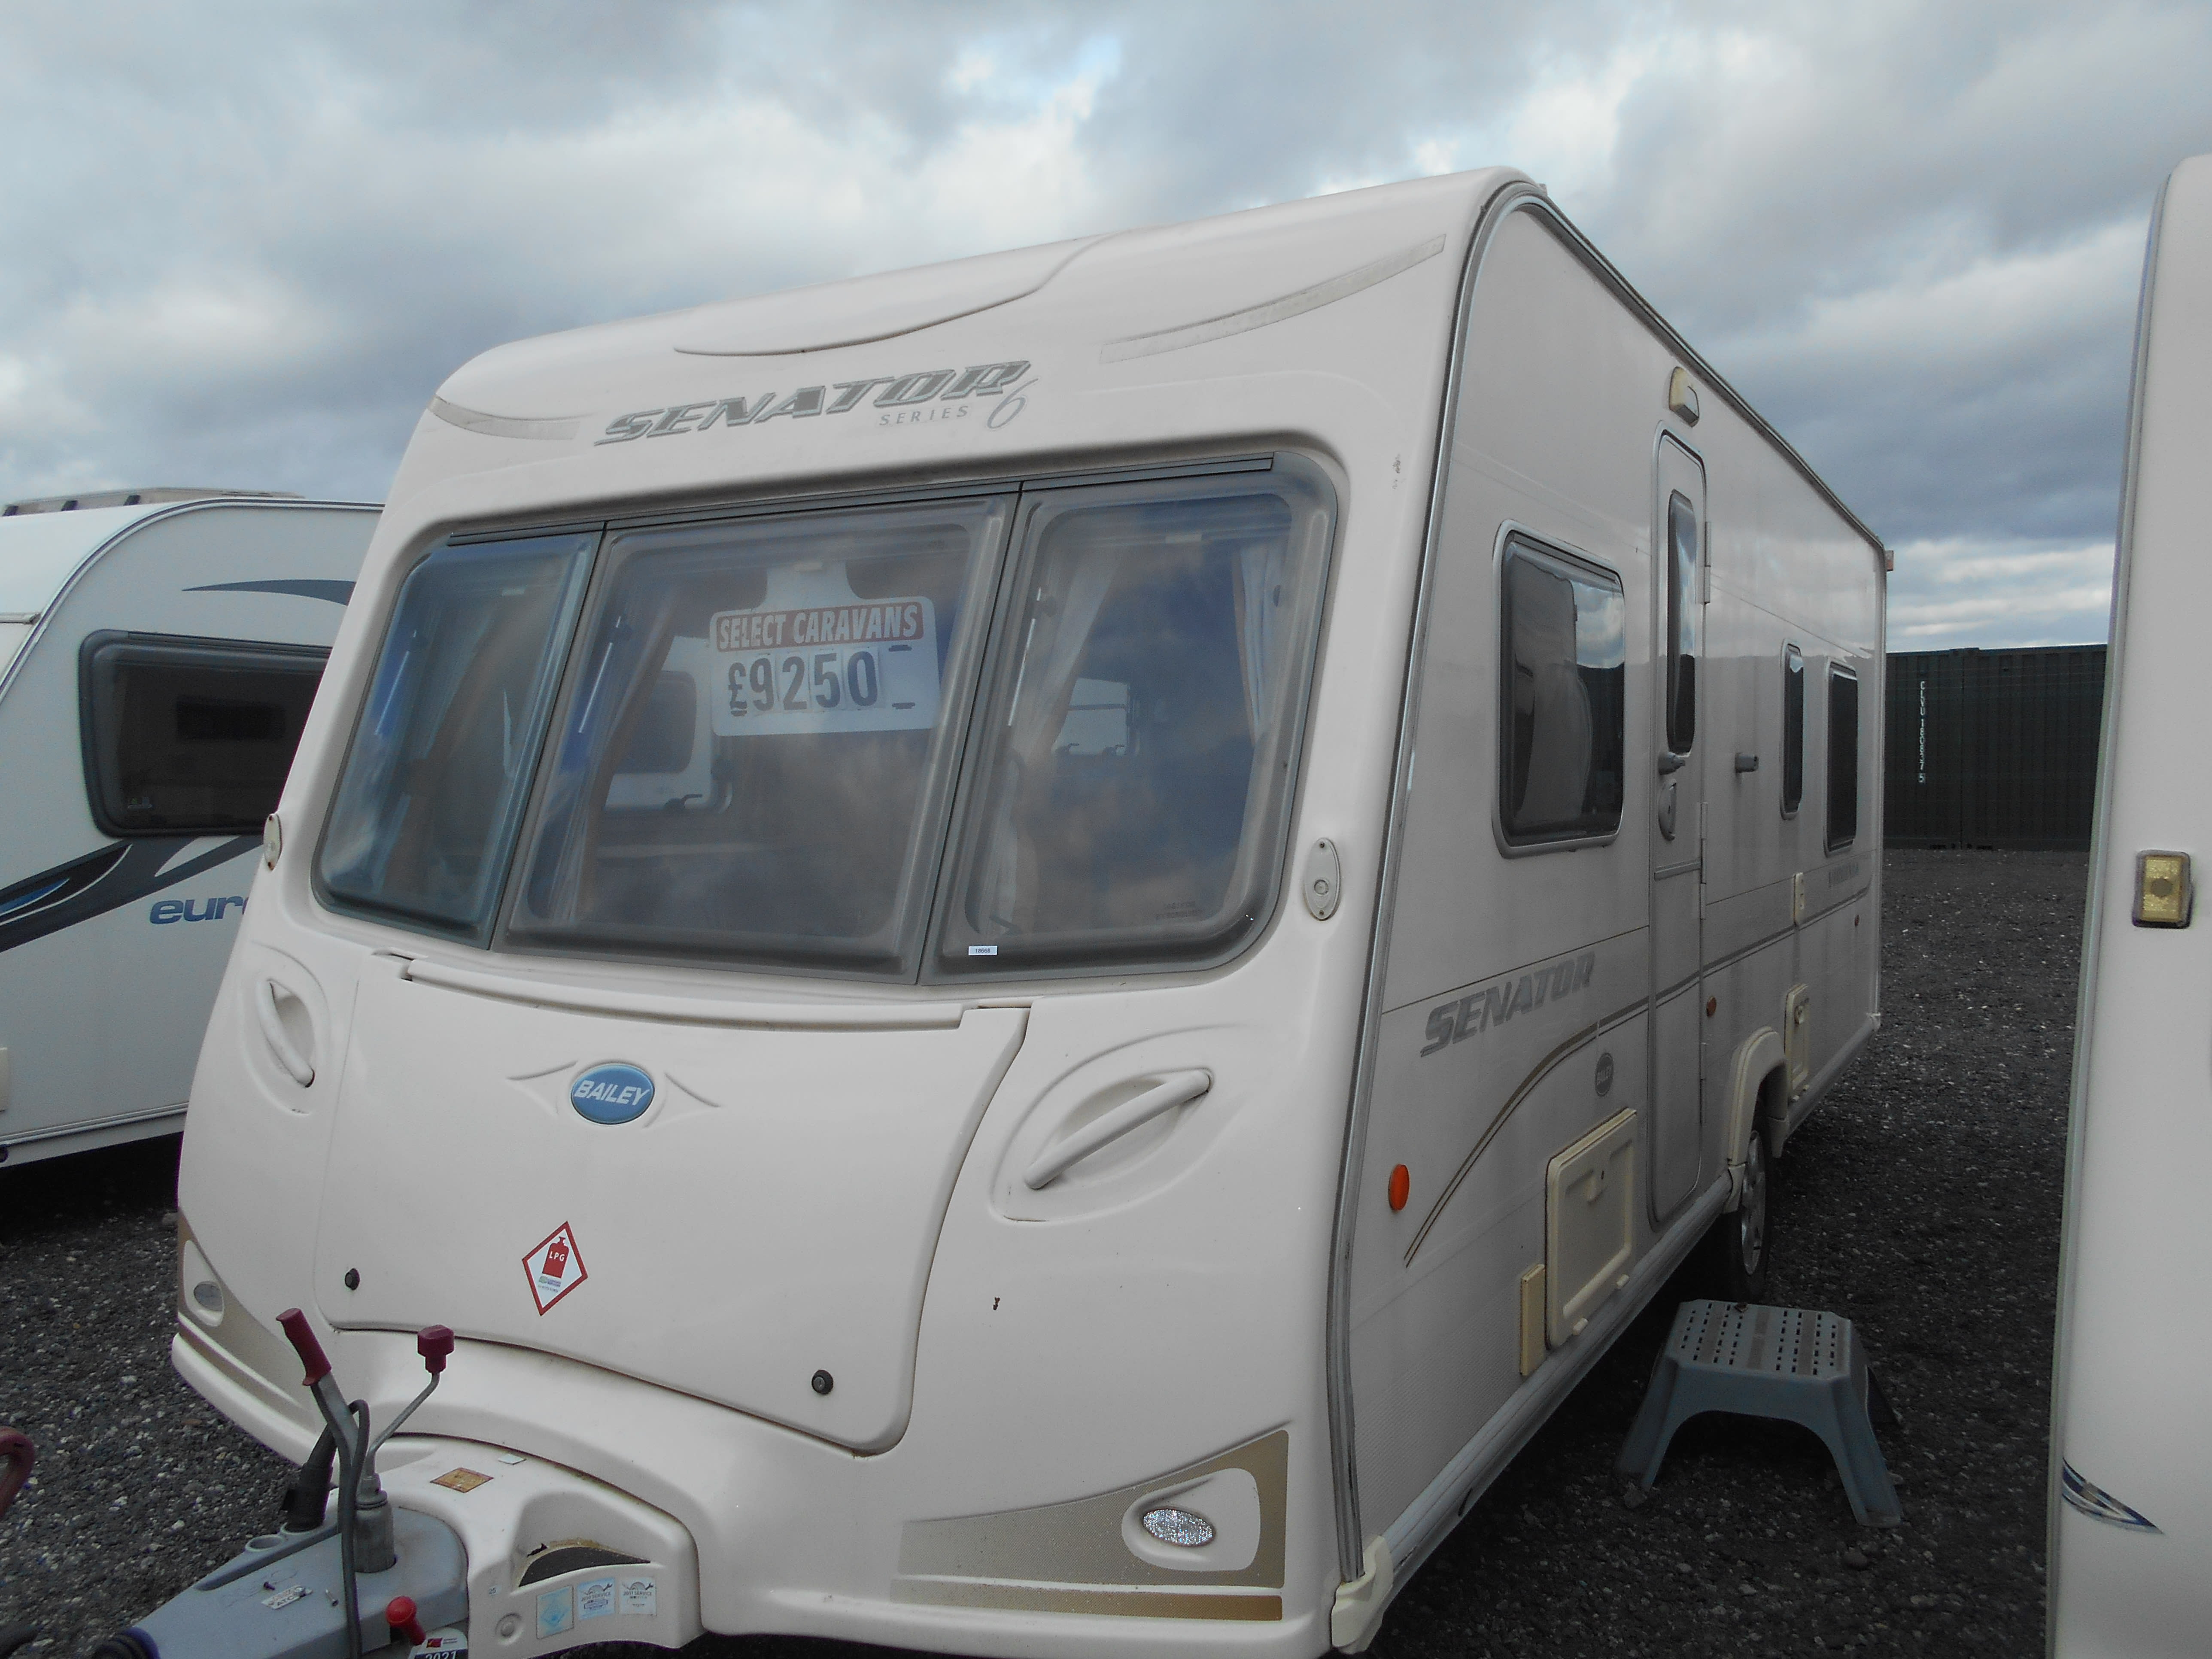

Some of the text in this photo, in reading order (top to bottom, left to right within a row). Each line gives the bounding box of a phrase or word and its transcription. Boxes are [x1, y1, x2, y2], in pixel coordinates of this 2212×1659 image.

[595, 360, 1030, 446] SENATOR
[879, 404, 969, 427] SERIES
[720, 604, 918, 649] SELECT CARAVANS
[728, 651, 878, 717] £9250
[149, 896, 249, 925] eur
[1420, 951, 1595, 1057] SENATOR
[574, 1080, 650, 1106] BAILEY
[549, 1251, 565, 1262] LPG
